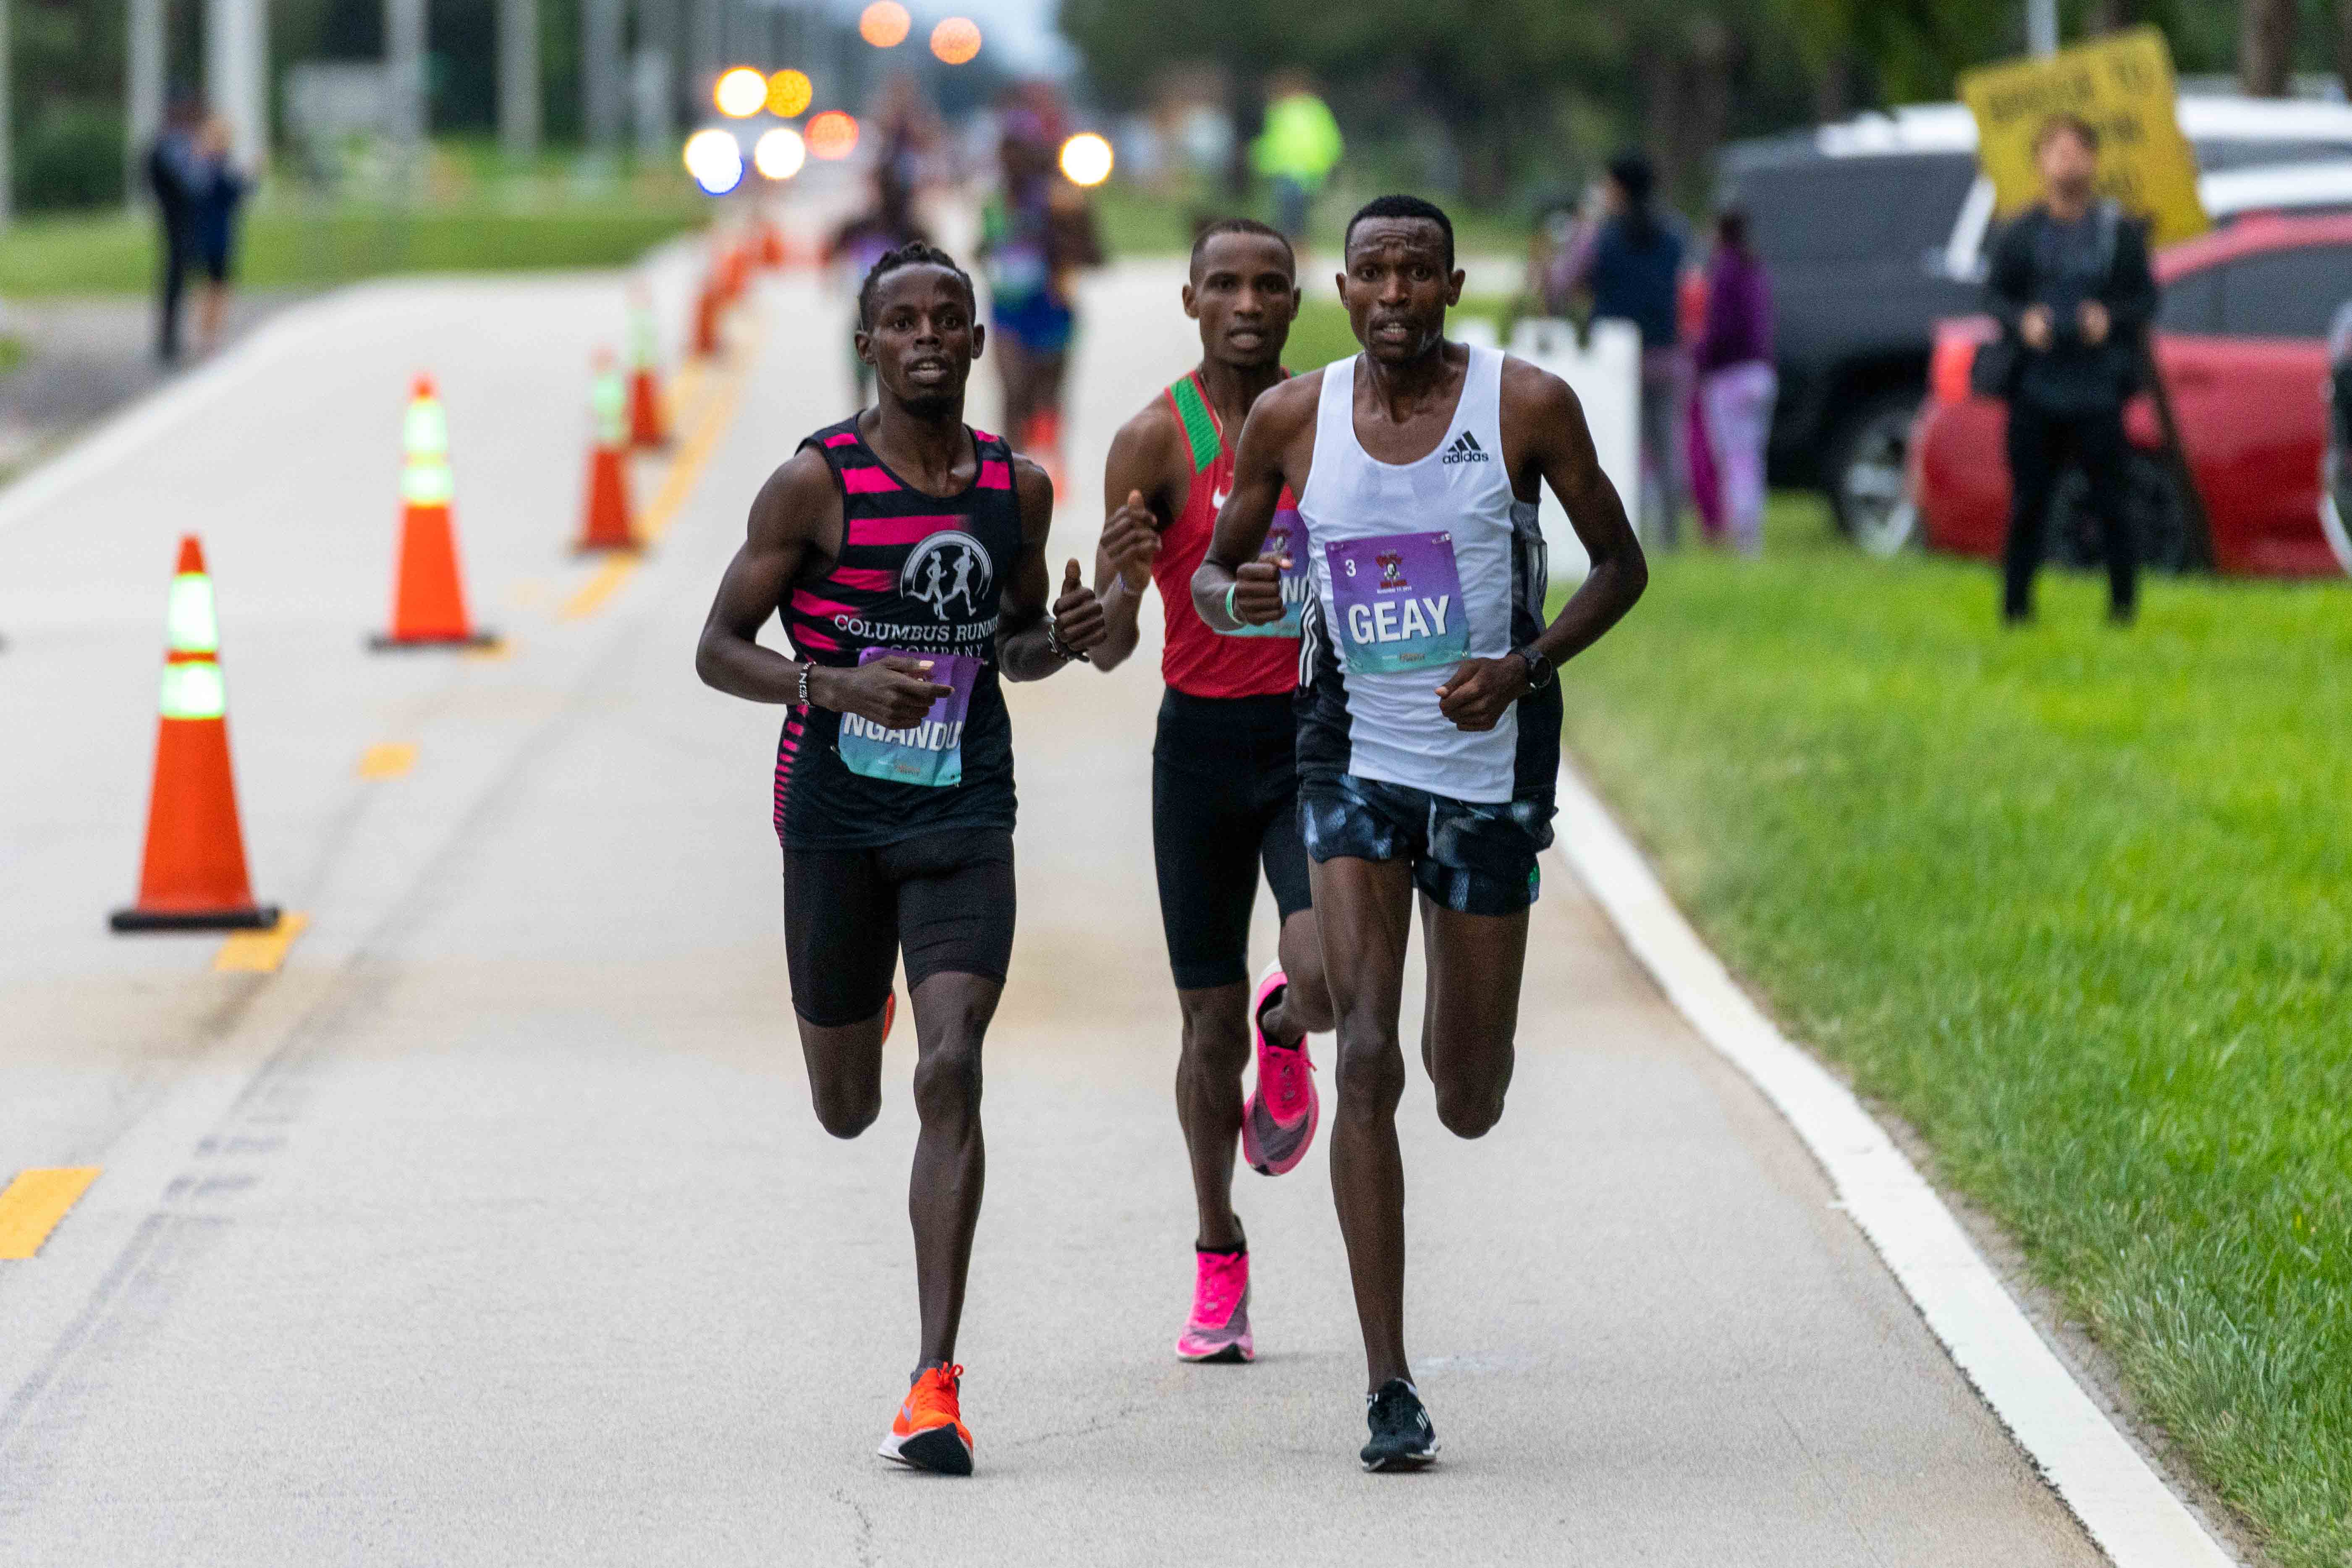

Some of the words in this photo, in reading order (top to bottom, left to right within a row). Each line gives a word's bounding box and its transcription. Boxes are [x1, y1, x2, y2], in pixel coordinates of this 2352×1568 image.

[1442, 450, 1489, 464] adidas
[1345, 559, 1357, 577] 3
[834, 614, 950, 642] COLUMBUS
[1348, 594, 1449, 645] GEAY
[843, 712, 962, 751] NGANDU
